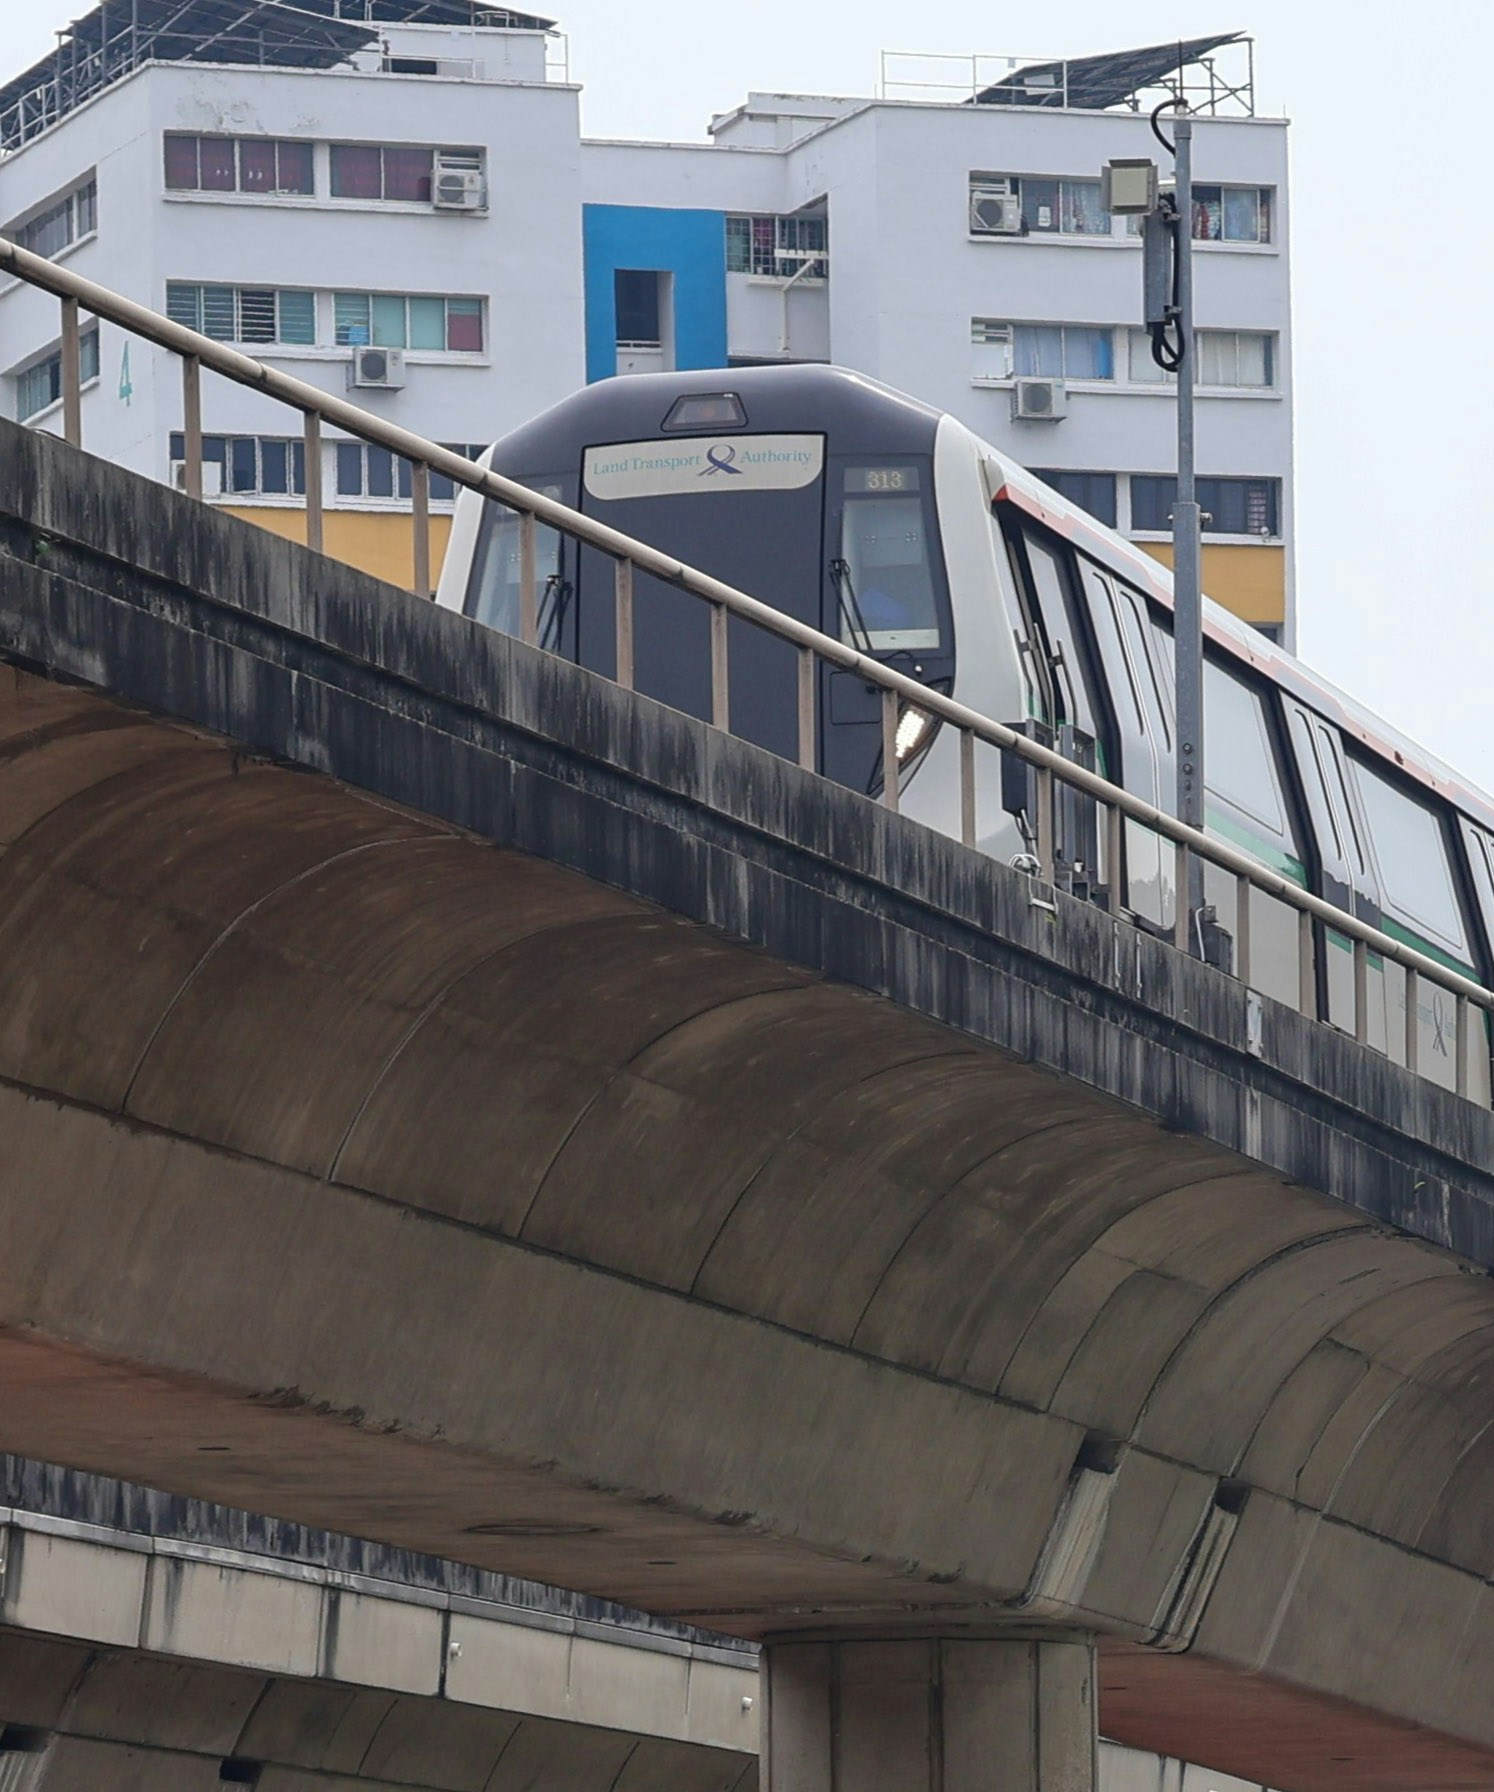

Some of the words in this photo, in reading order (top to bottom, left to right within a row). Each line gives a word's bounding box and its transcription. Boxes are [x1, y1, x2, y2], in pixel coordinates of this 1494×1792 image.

[593, 460, 628, 476] Land
[632, 454, 700, 471] Transport
[740, 449, 812, 465] Authority
[868, 471, 902, 489] 313
